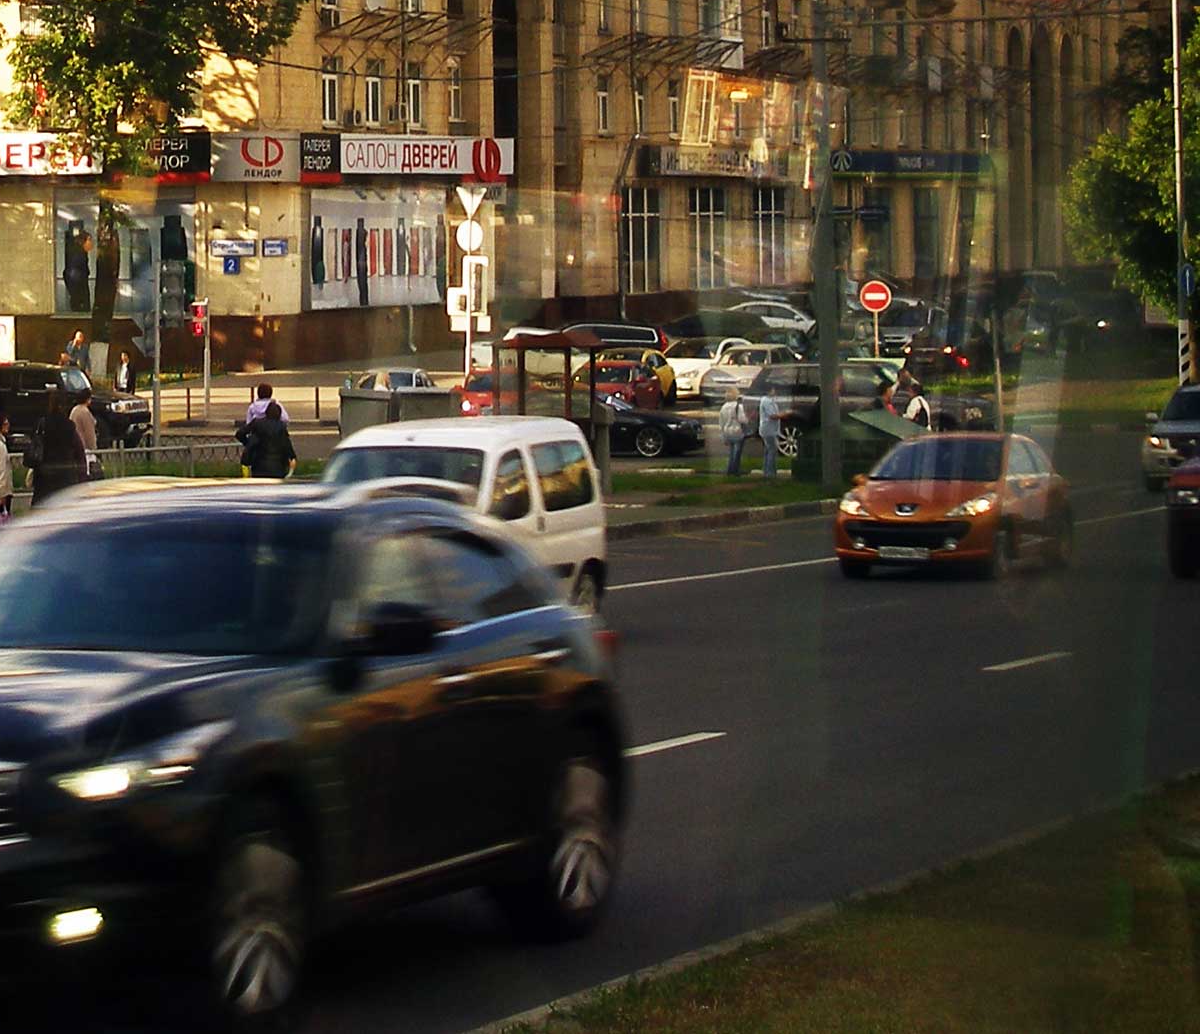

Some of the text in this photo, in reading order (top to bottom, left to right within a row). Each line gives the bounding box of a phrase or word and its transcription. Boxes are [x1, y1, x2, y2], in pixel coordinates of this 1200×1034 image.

[303, 139, 331, 152] ГАЛЕРЕЯ
[346, 140, 458, 172] САЛОН ДВЕРЕЙ
[303, 156, 332, 171] ЛЕНДОР
[244, 168, 283, 178] ЛЕНДОР
[227, 259, 236, 271] 2
